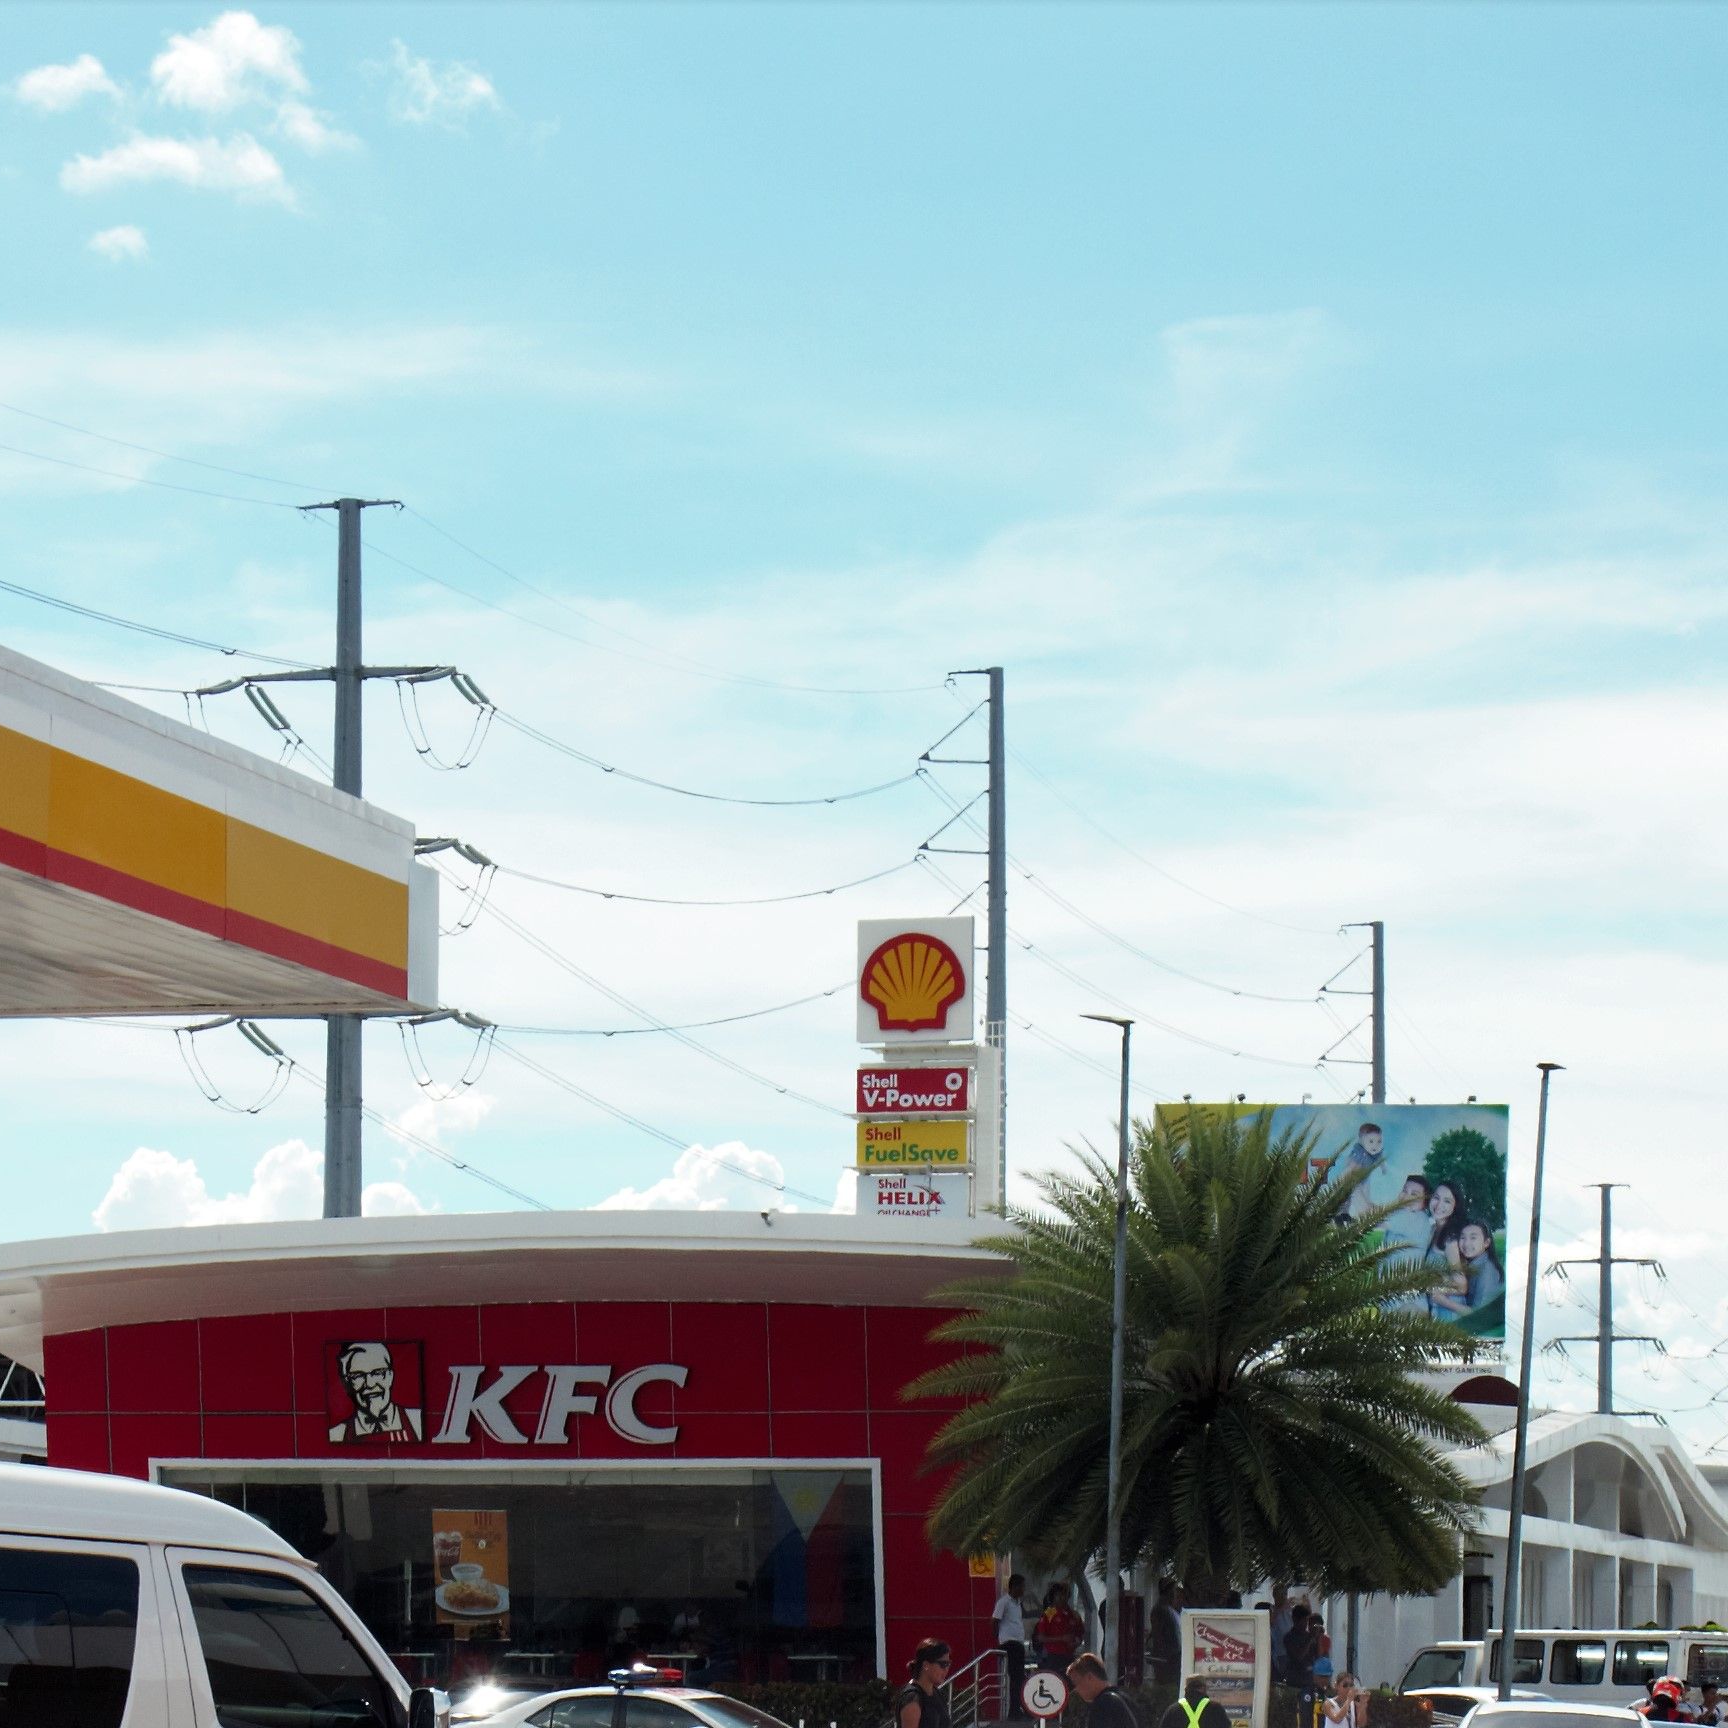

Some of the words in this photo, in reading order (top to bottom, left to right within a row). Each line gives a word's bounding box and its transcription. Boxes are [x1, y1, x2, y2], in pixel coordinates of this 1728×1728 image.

[862, 1074, 898, 1088] Shell
[862, 1089, 957, 1107] V-Power
[864, 1127, 901, 1141] Shell
[864, 1143, 959, 1162] FuelSave
[878, 1179, 906, 1189] Shell
[877, 1191, 942, 1205] HELIX
[431, 1363, 689, 1445] KFC
